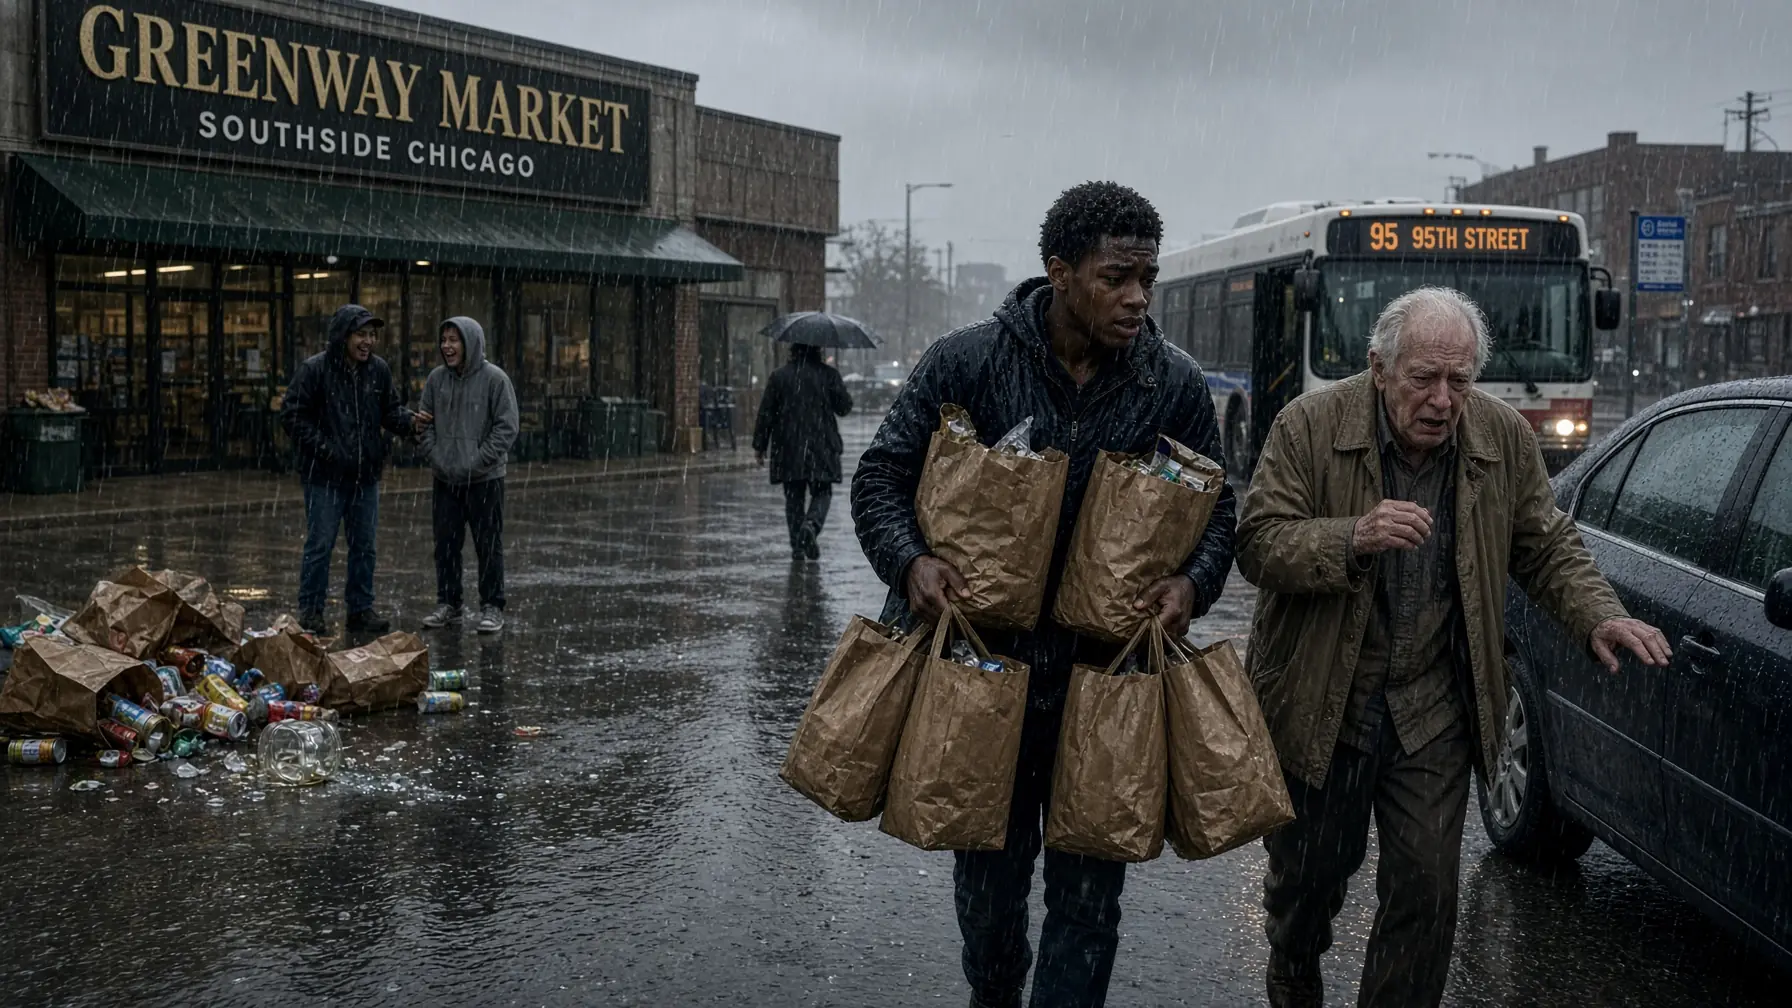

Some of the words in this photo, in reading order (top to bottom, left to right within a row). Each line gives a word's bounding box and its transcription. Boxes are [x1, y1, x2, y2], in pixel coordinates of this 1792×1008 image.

[79, 5, 422, 123] GREENWAY
[438, 69, 630, 154] MARKET
[199, 111, 392, 161] SOUTHSIDE
[407, 140, 535, 178] CHICAGO
[1370, 222, 1399, 250] 95
[1412, 226, 1458, 249] 95TH
[1464, 227, 1529, 250] STREET
